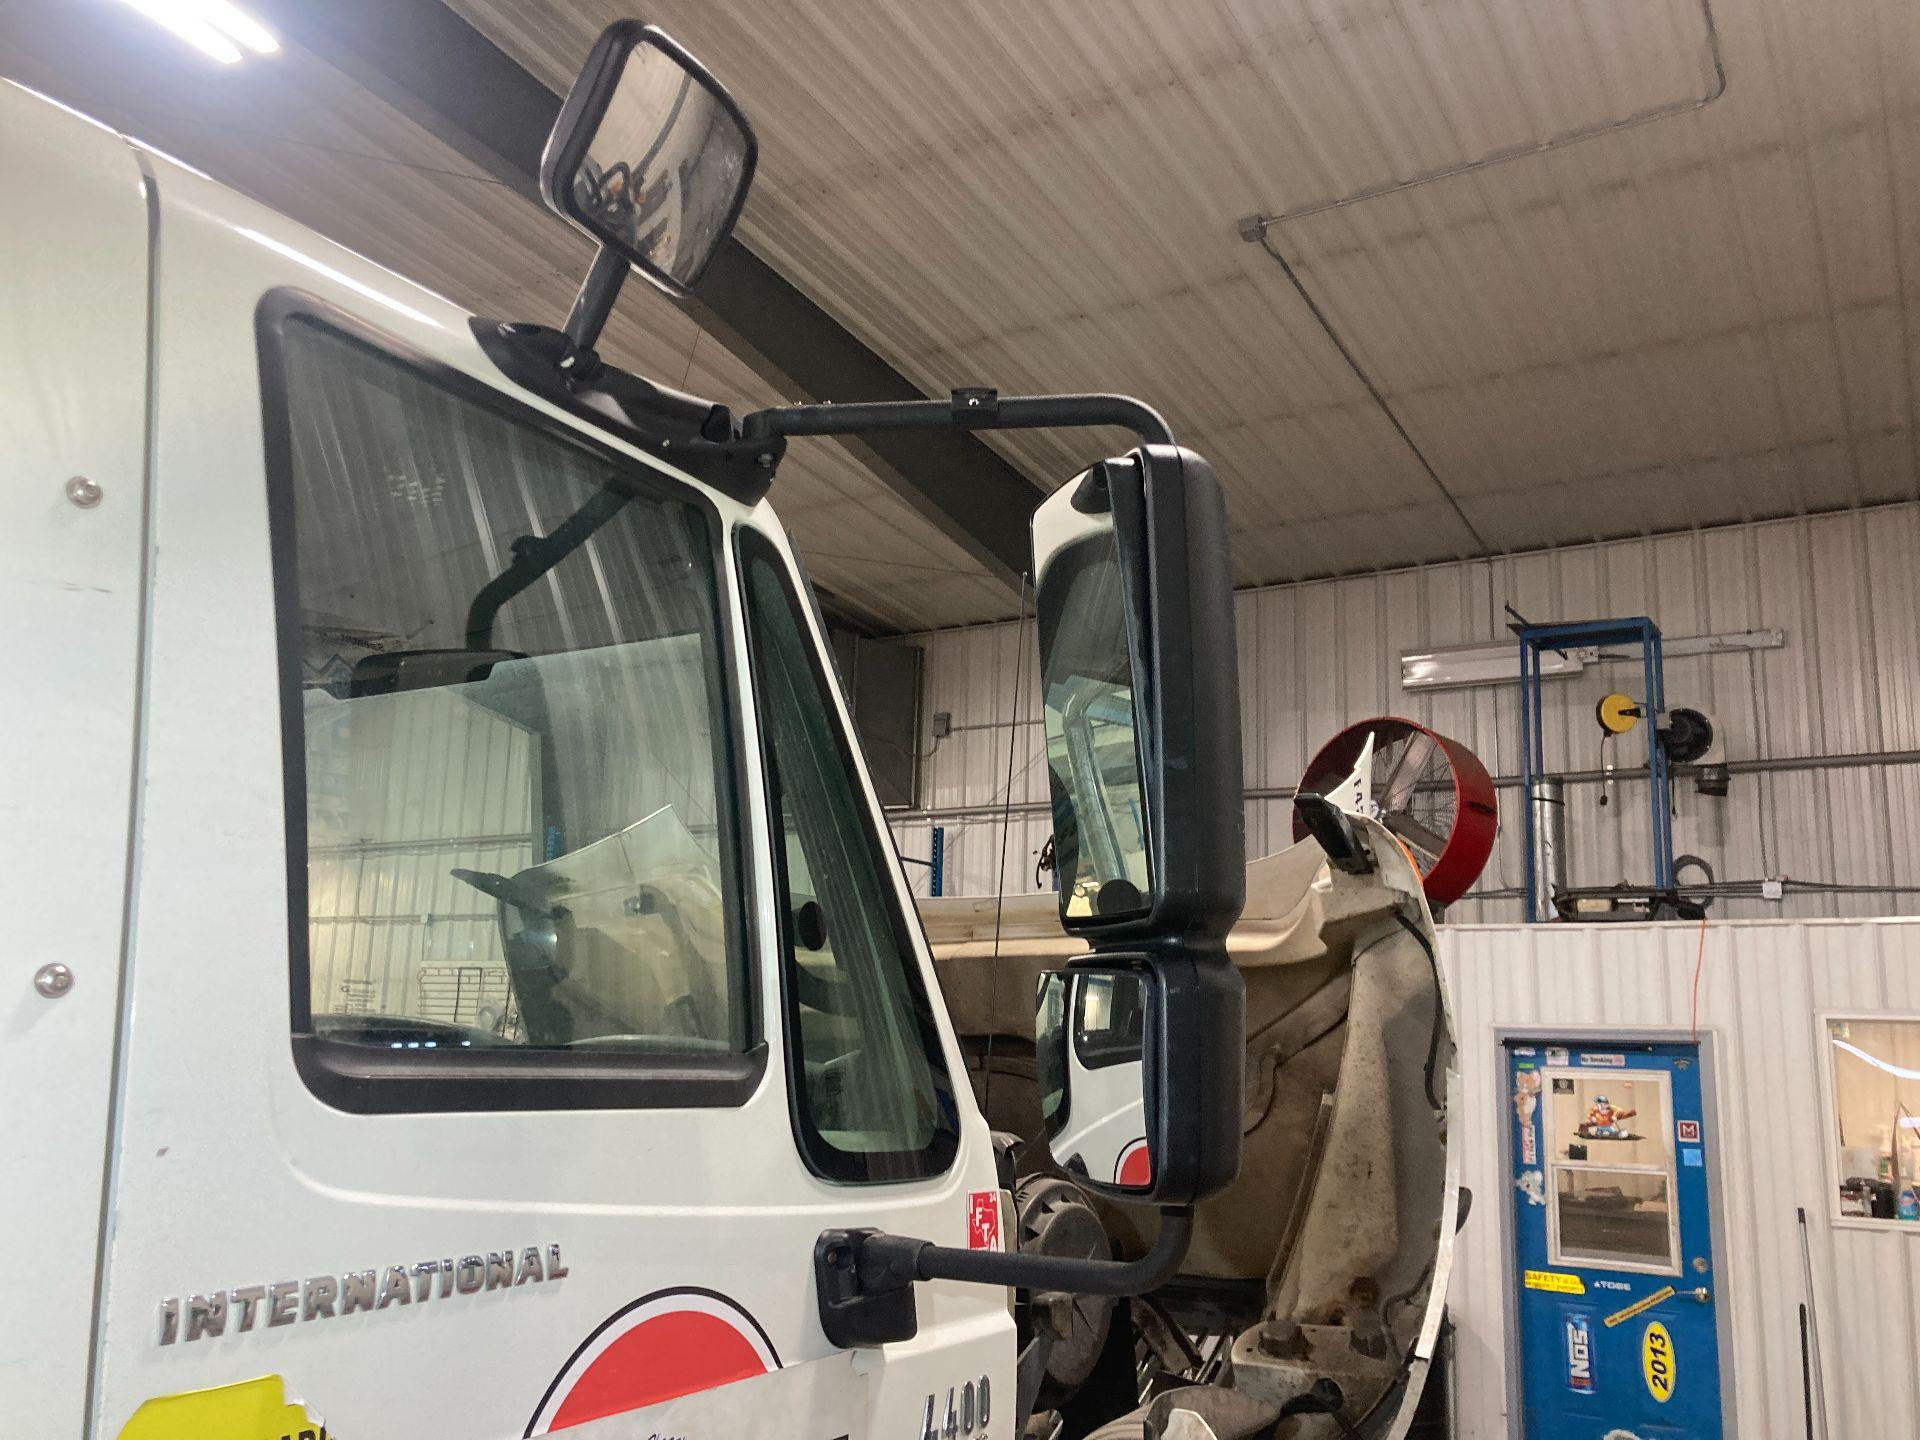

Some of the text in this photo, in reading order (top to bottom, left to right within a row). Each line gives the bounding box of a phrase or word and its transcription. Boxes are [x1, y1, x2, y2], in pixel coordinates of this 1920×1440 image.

[159, 1243, 569, 1346] INTERNATIONAL
[1525, 1272, 1560, 1283] SAFETY
[1566, 1321, 1591, 1379] NOS
[1649, 1332, 1669, 1392] 2013
[918, 1374, 991, 1440] 4400
